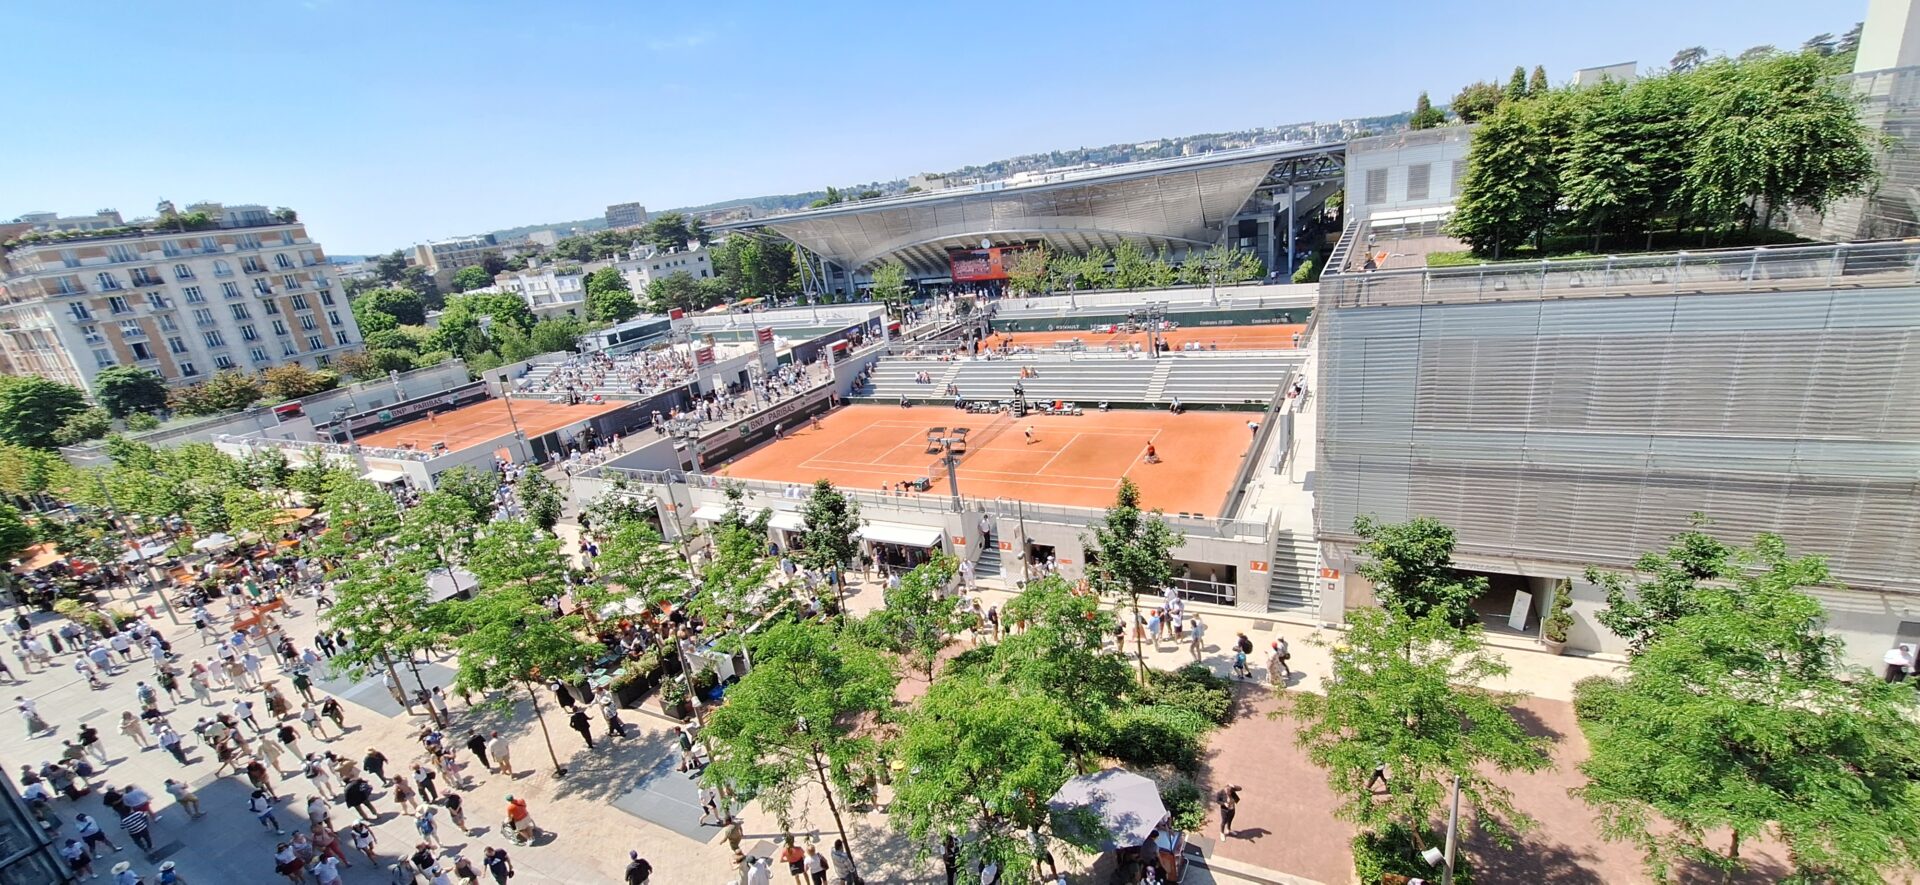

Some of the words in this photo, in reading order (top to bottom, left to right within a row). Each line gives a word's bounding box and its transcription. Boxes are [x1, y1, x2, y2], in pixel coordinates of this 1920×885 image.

[391, 407, 407, 418] BNP
[412, 398, 443, 411] PARIBAS
[750, 416, 765, 430] BNP
[768, 404, 796, 422] PARIBAS
